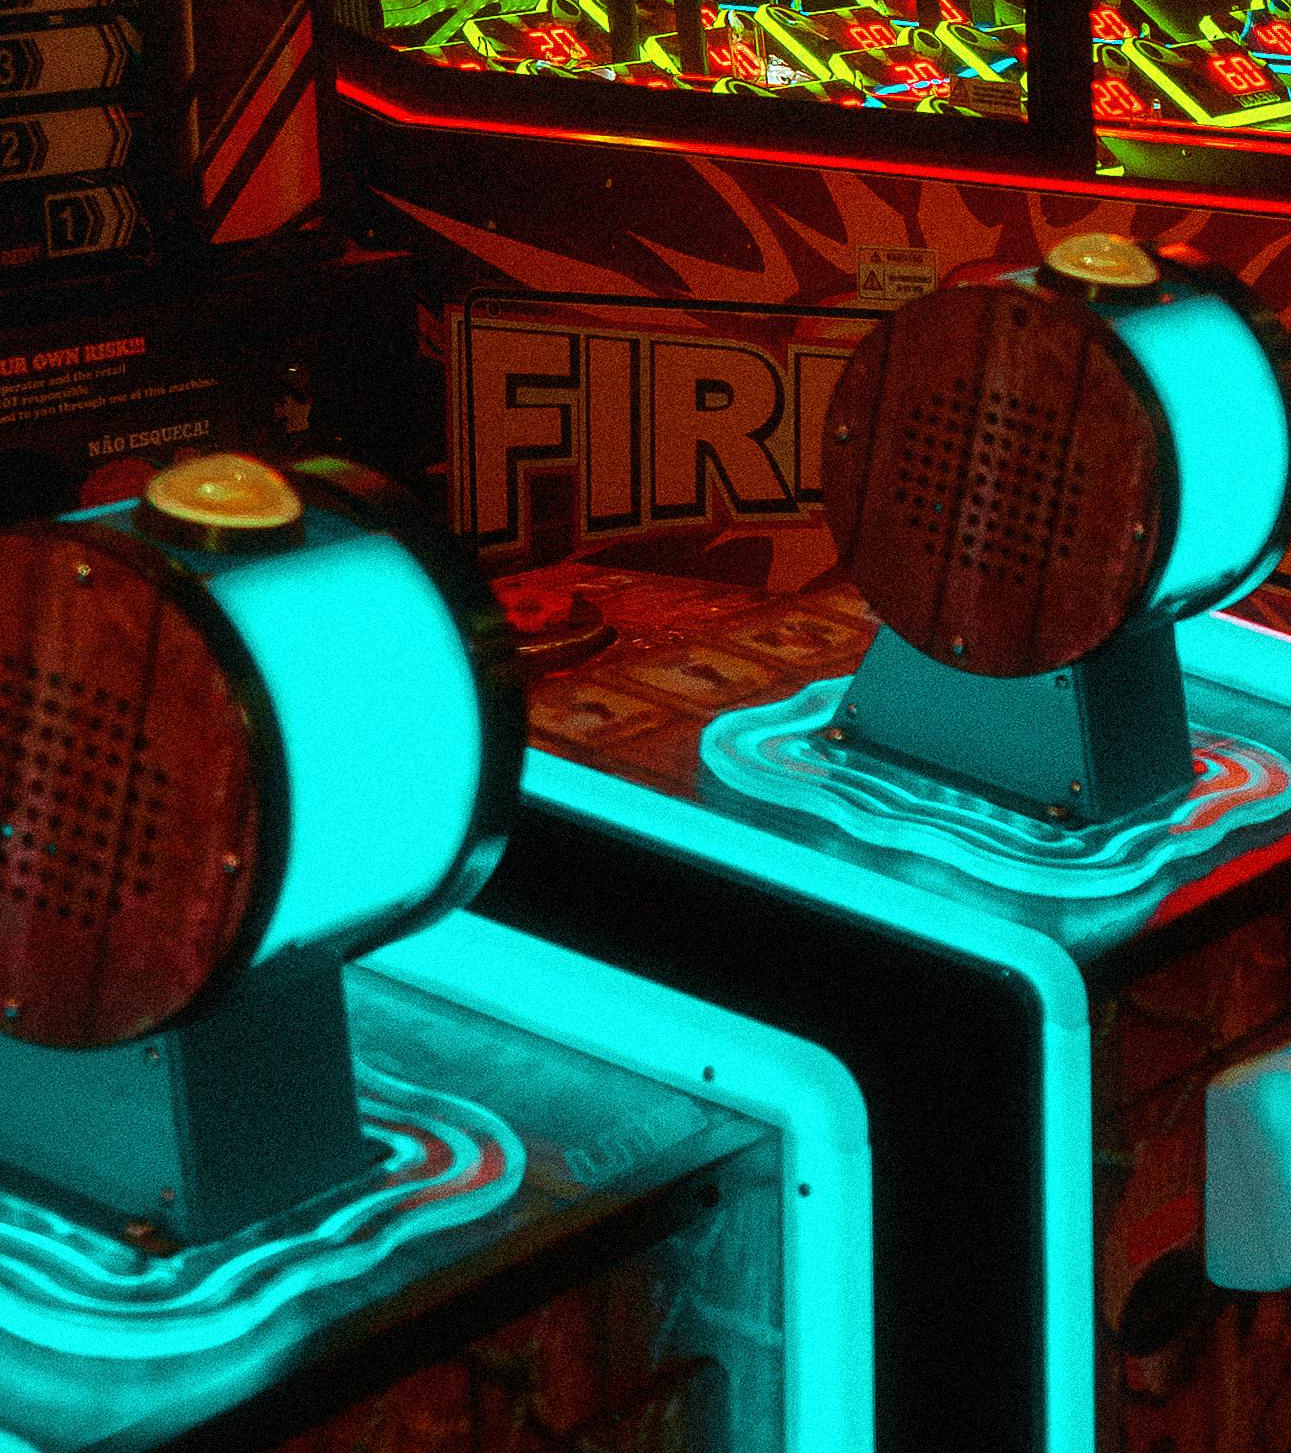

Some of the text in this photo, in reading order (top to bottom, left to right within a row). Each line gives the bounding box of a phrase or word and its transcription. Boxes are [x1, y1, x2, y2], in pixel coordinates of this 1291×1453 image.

[1211, 56, 1267, 91] 60
[32, 347, 80, 371] OWN
[87, 433, 125, 458] NÃO
